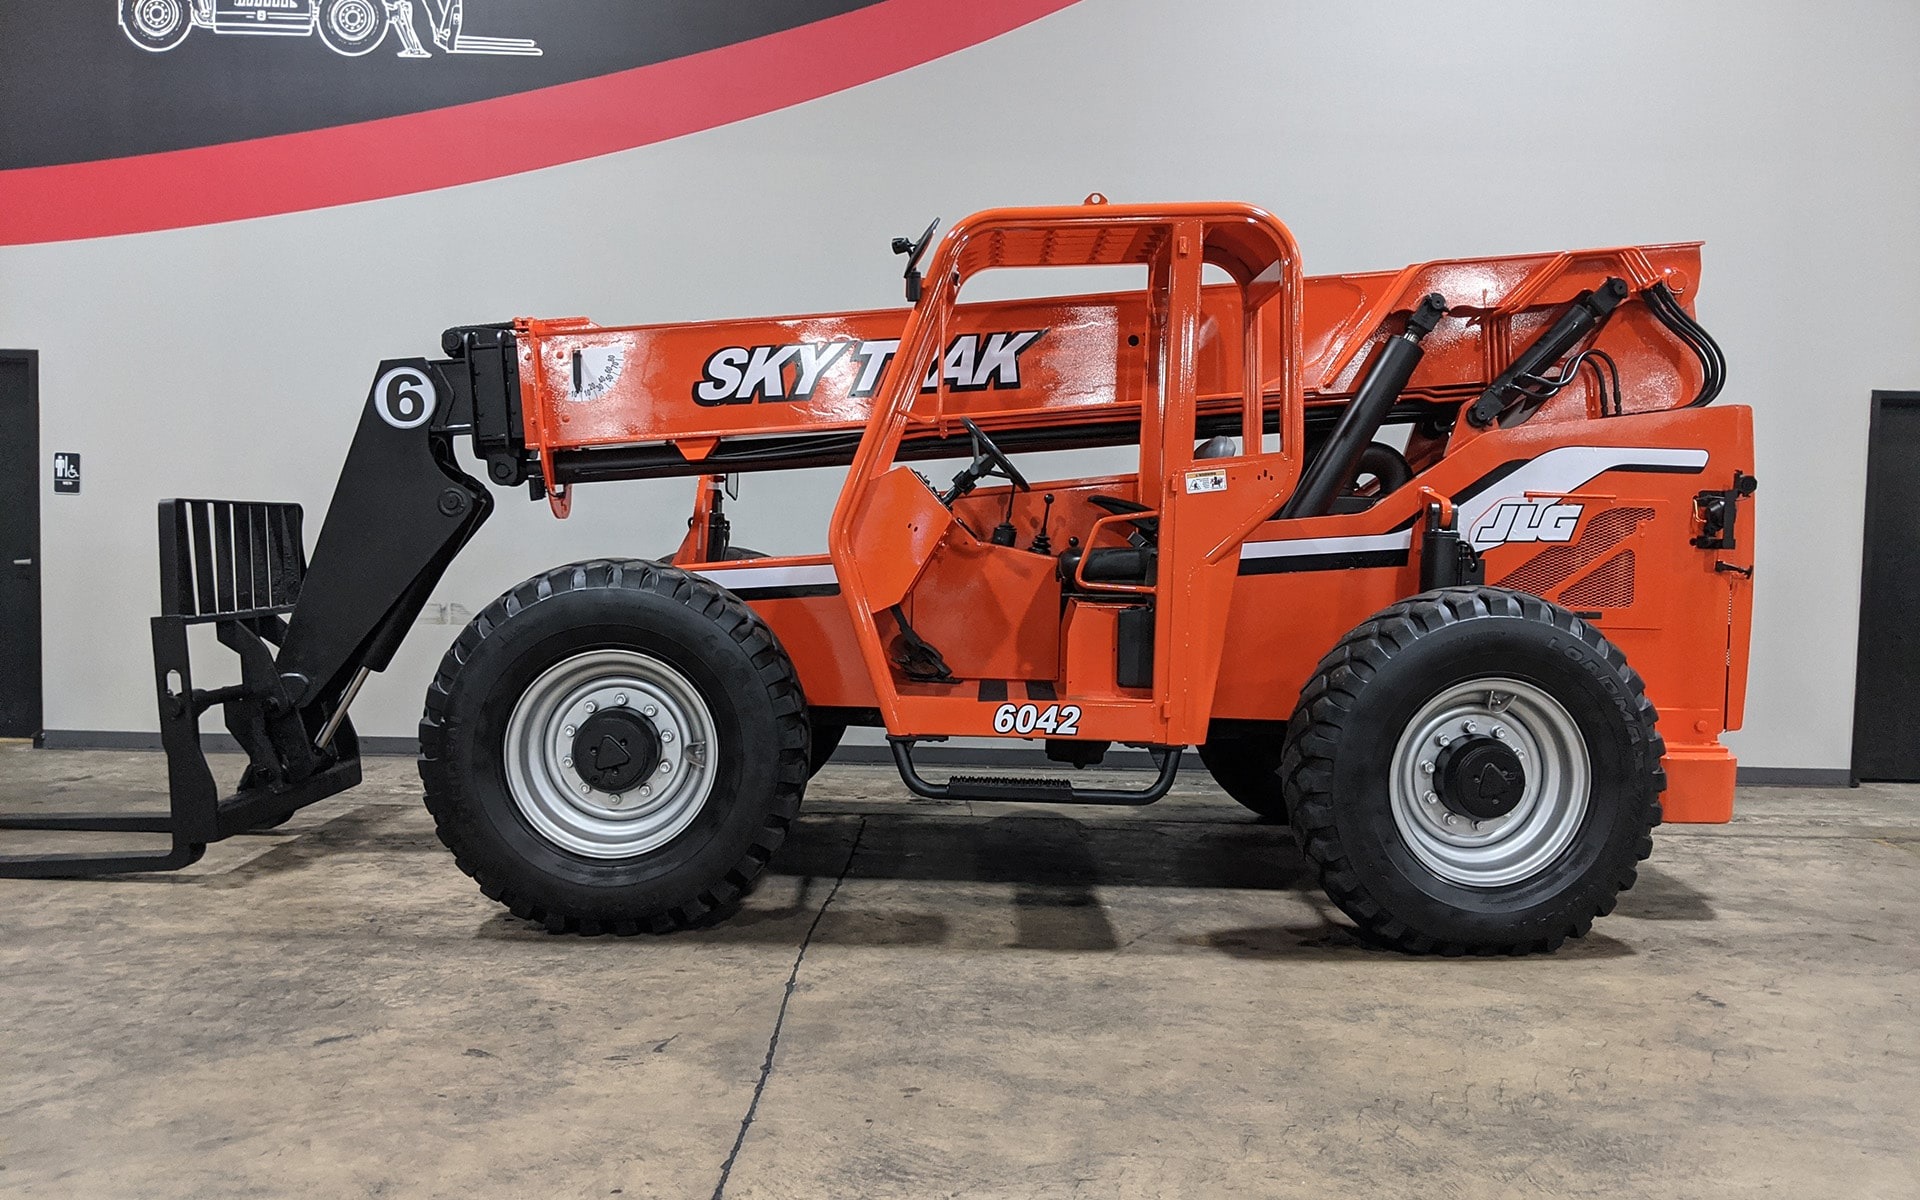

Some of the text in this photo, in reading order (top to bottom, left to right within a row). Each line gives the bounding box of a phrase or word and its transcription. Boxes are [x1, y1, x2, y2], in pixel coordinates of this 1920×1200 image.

[849, 329, 1047, 398] TAK
[386, 373, 425, 422] 6
[1475, 503, 1585, 543] JLG
[993, 703, 1082, 735] 6042
